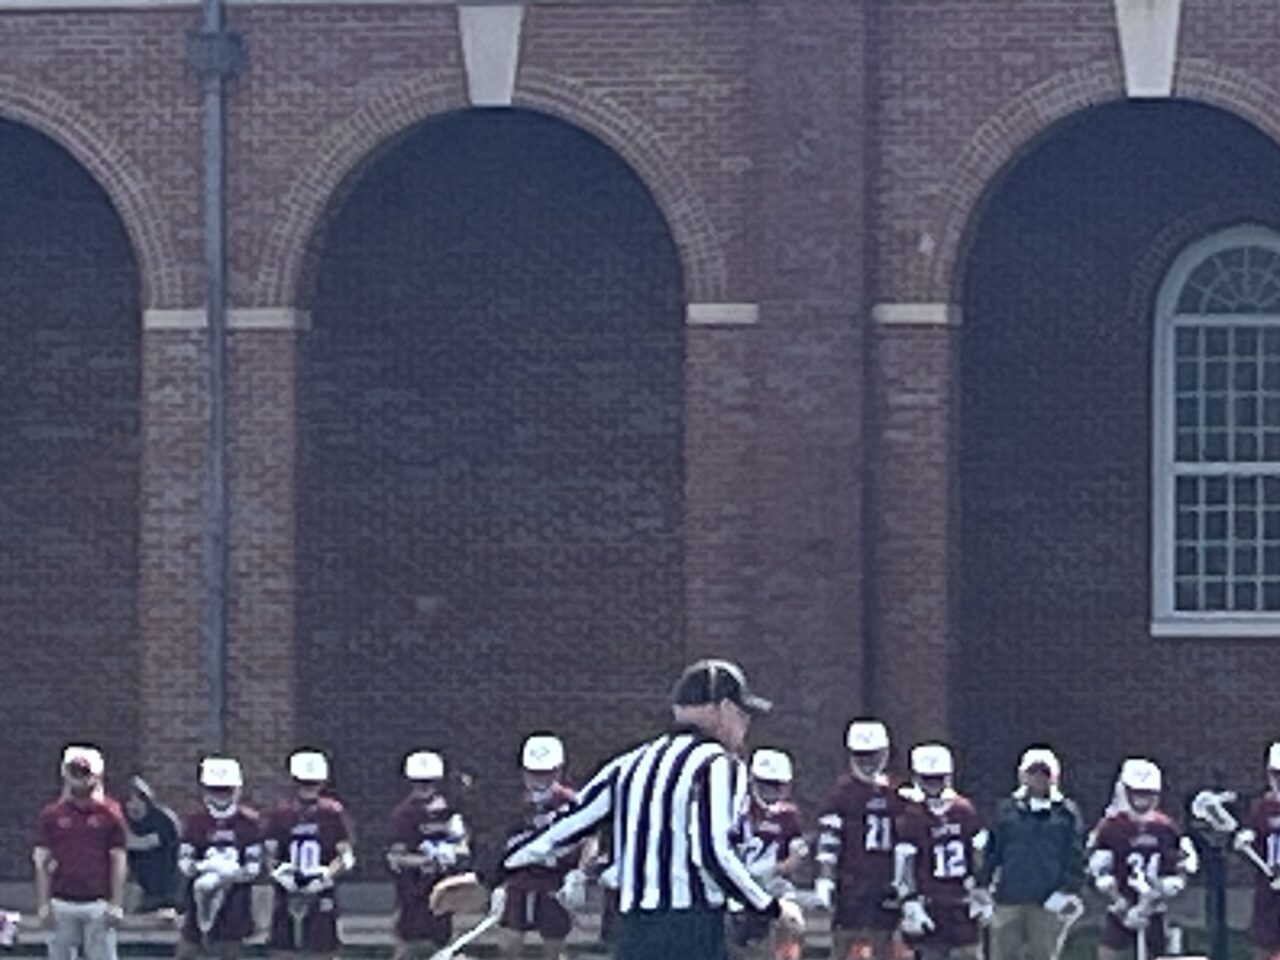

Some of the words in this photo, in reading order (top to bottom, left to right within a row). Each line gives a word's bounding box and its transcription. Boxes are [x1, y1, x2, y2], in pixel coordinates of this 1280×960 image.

[865, 814, 893, 851] 21
[290, 840, 322, 876] 10
[933, 840, 968, 878] 12
